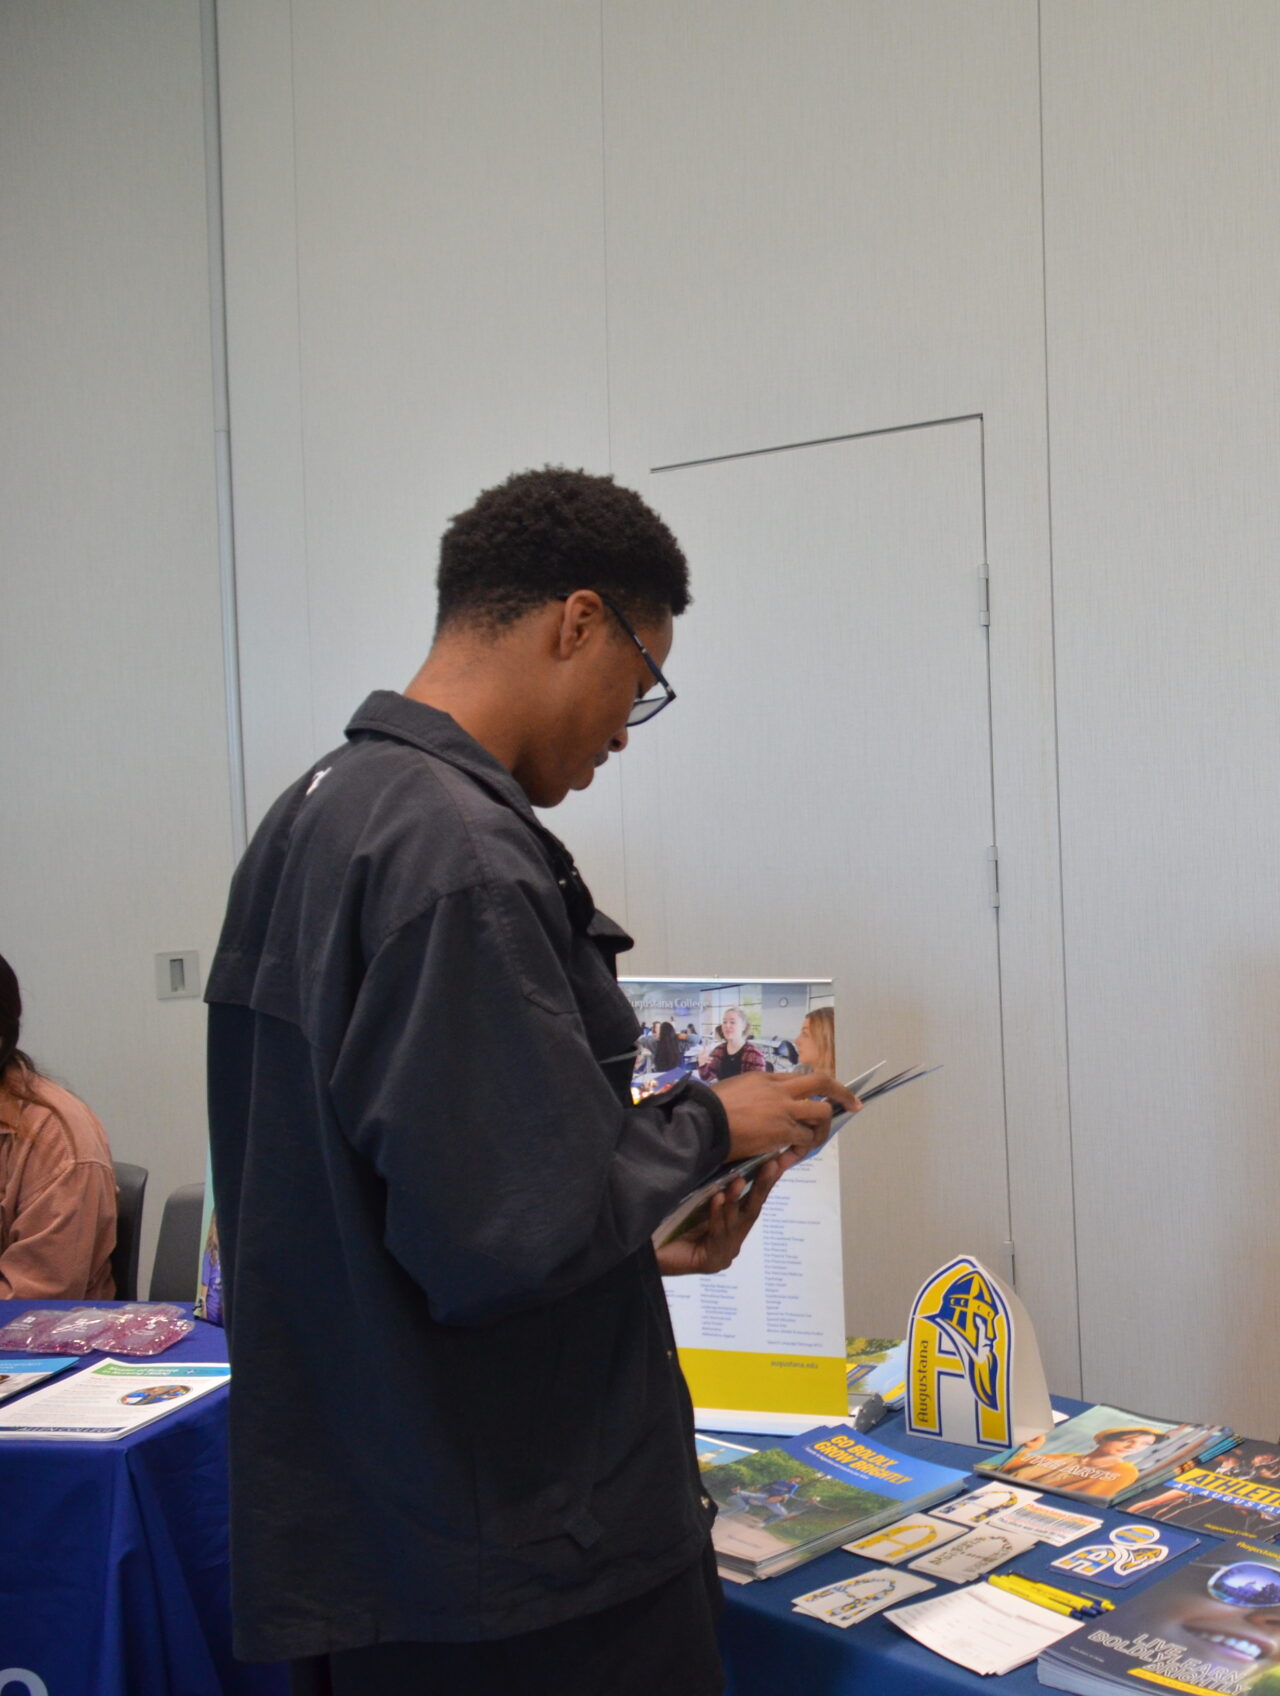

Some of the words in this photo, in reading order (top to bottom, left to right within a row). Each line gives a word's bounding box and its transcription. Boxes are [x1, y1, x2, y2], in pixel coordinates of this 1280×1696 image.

[631, 1000, 673, 1011] ugustana
[917, 1340, 931, 1423] Augustana
[831, 1435, 855, 1448] GO
[814, 1441, 858, 1464] GROW
[1173, 1483, 1192, 1492] AT
